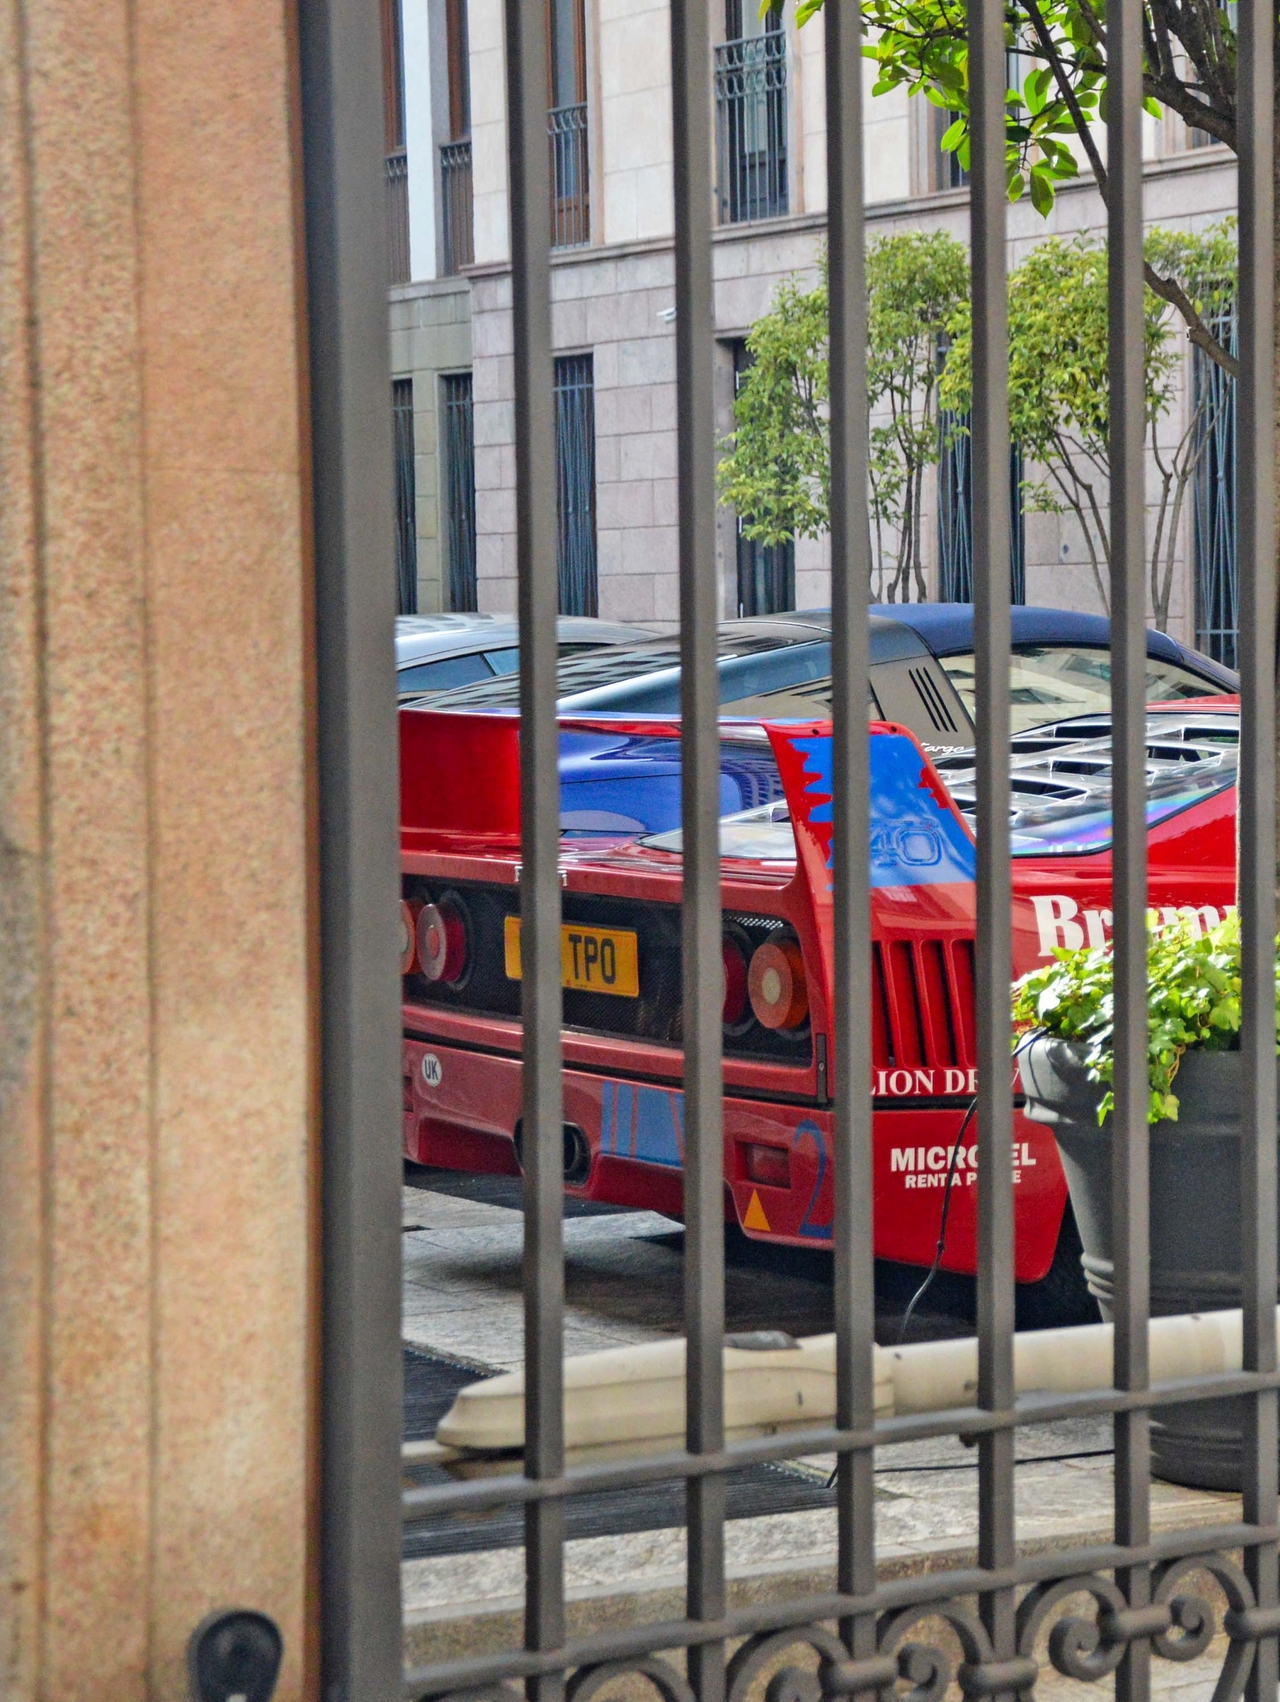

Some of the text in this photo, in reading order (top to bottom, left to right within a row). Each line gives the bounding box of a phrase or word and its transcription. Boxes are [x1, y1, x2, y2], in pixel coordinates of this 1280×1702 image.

[568, 934, 616, 984] TPO
[424, 1059, 439, 1080] UK
[871, 1069, 935, 1095] ION
[793, 1119, 833, 1239] 2
[905, 1173, 947, 1189] RENT
[950, 1172, 962, 1187] A
